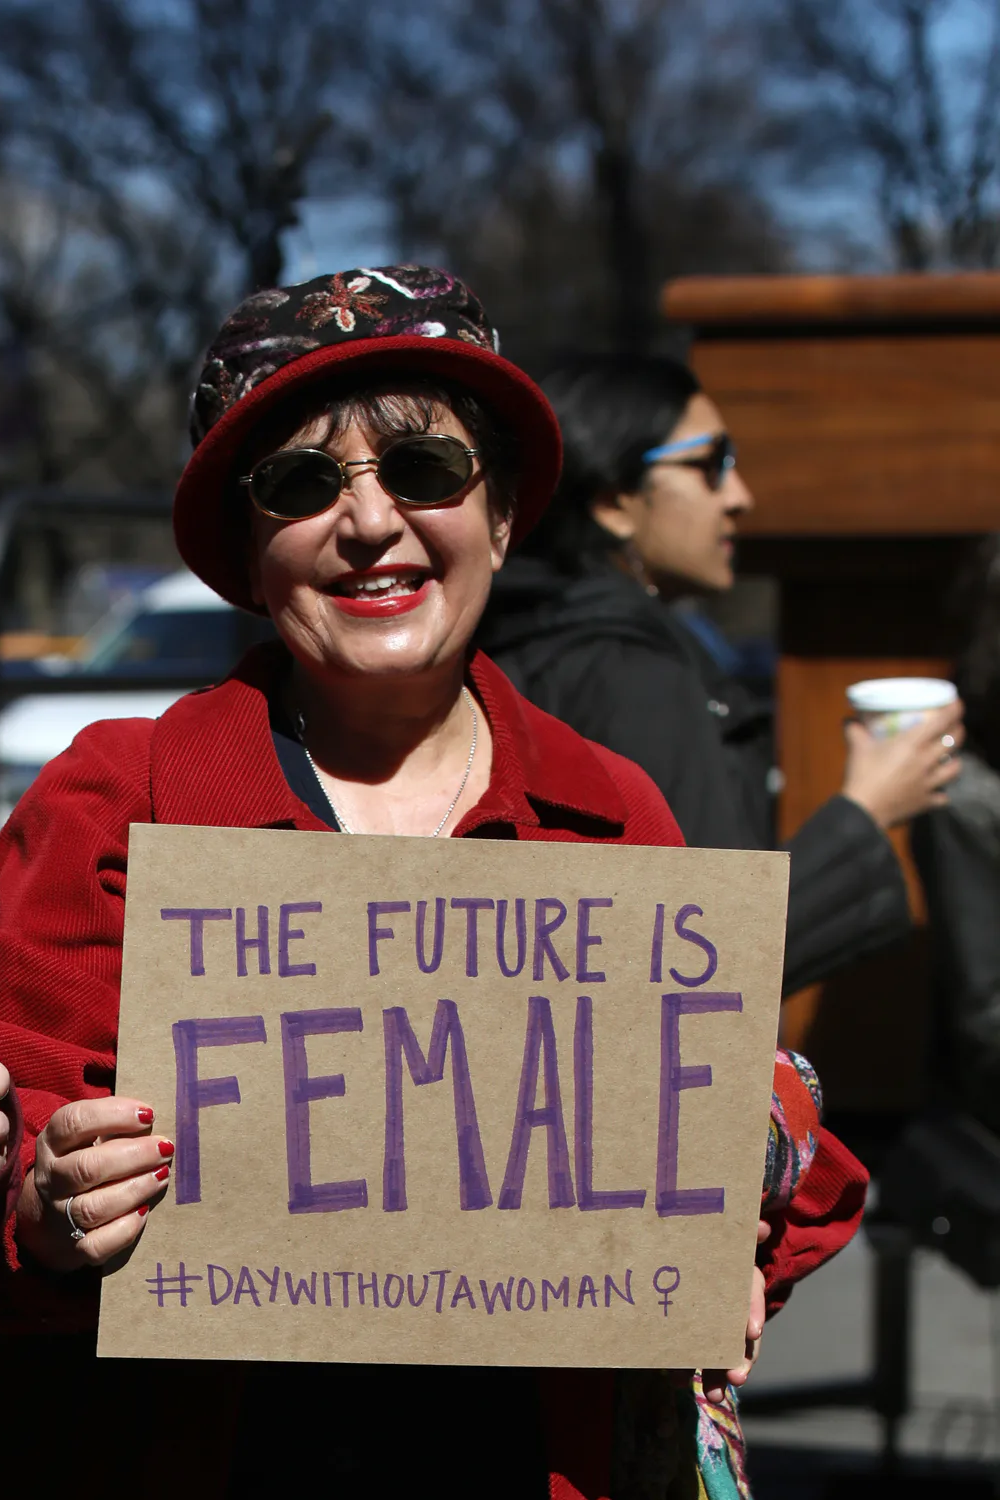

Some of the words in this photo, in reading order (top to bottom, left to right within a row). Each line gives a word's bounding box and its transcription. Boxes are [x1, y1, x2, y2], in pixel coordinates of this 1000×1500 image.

[161, 902, 322, 976] THE
[368, 898, 612, 982] FUTURE
[650, 904, 716, 986] IS
[173, 993, 742, 1216] FEMALE
[146, 1262, 634, 1314] #DAYWITHOUTAWOMAN
